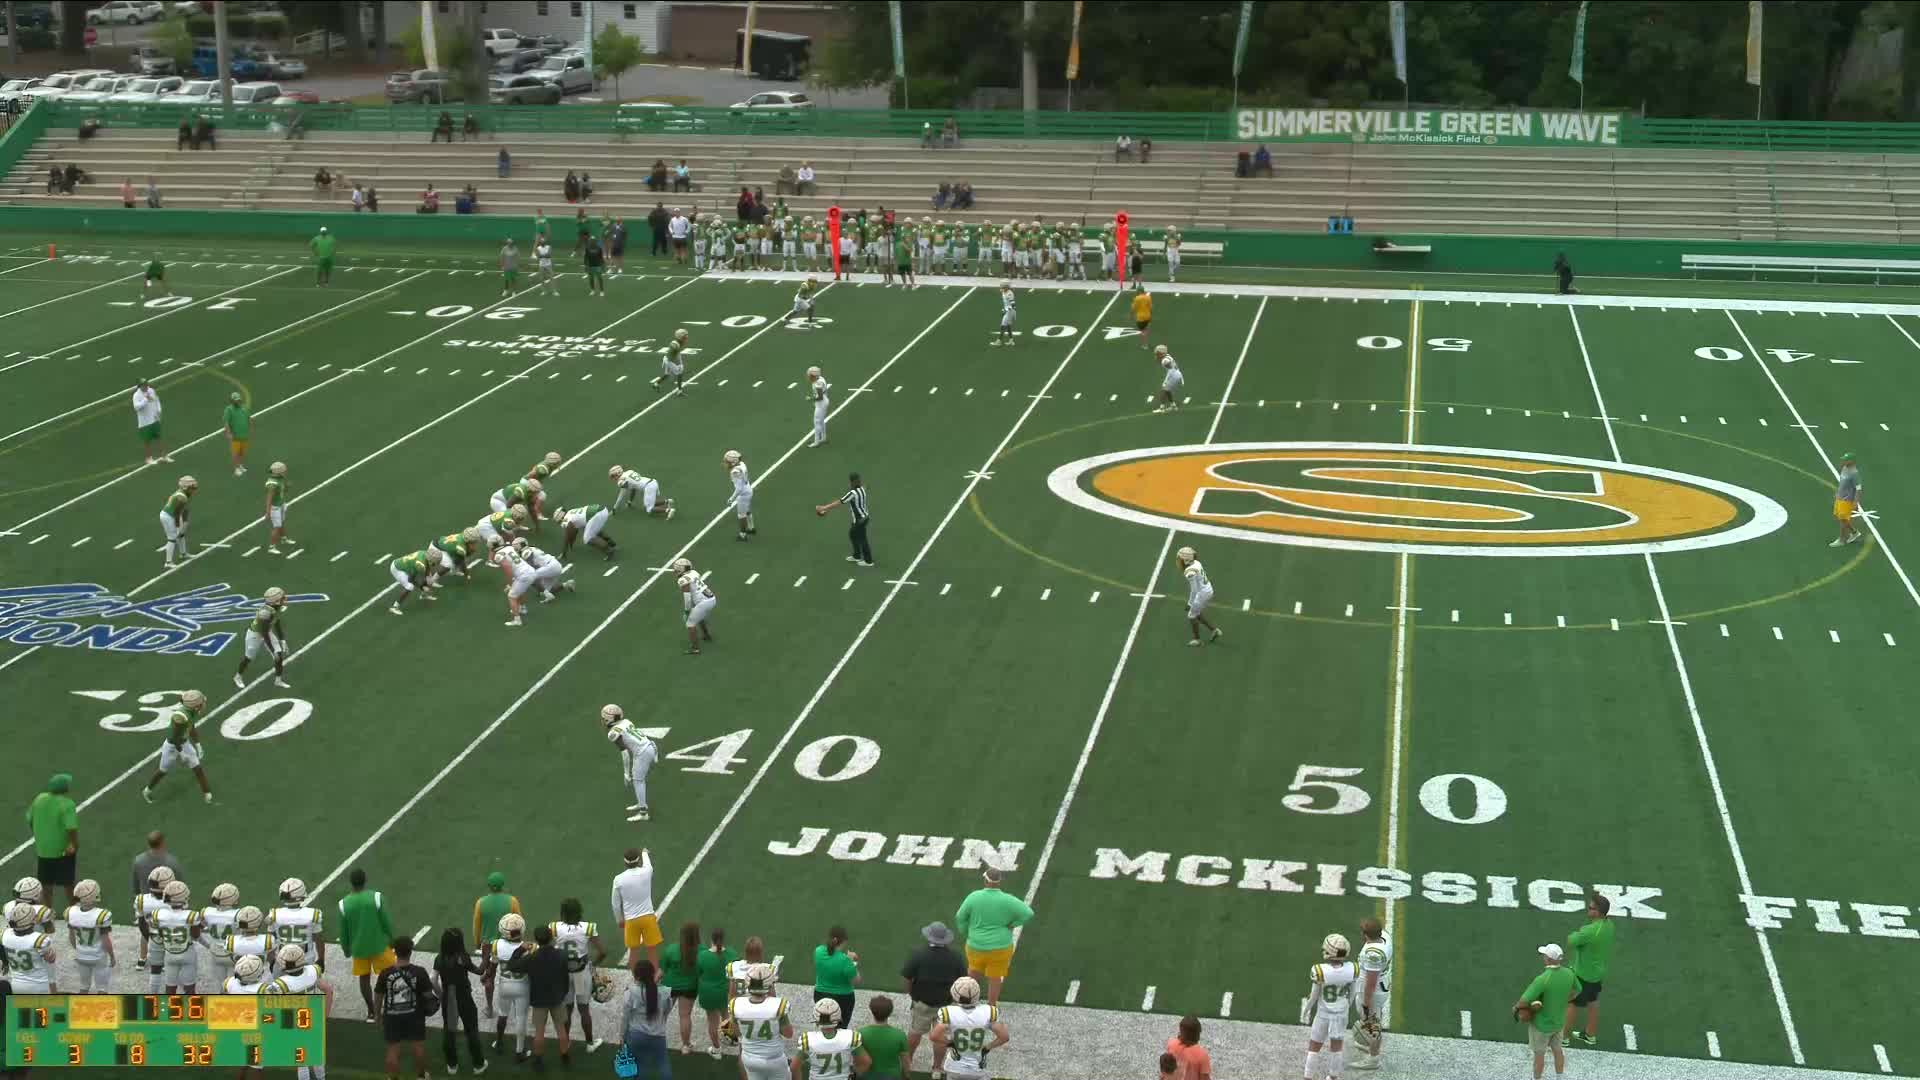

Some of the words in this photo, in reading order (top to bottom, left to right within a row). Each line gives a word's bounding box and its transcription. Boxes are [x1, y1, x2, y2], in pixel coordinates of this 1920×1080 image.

[1237, 109, 1431, 140] SUMMERVILLE
[1440, 112, 1532, 137] GREEN
[1542, 113, 1620, 145] WAVE
[1369, 134, 1396, 142] John
[1399, 134, 1453, 143] McKissick
[1455, 134, 1482, 143] Field
[443, 338, 703, 355] SUMMERVILLE
[517, 334, 617, 343] TOWN
[767, 826, 1026, 872] JOHN
[1089, 847, 1667, 920] MCKISSICK
[740, 1020, 773, 1040] 74
[953, 1028, 986, 1052] 69
[817, 1053, 843, 1075] 71
